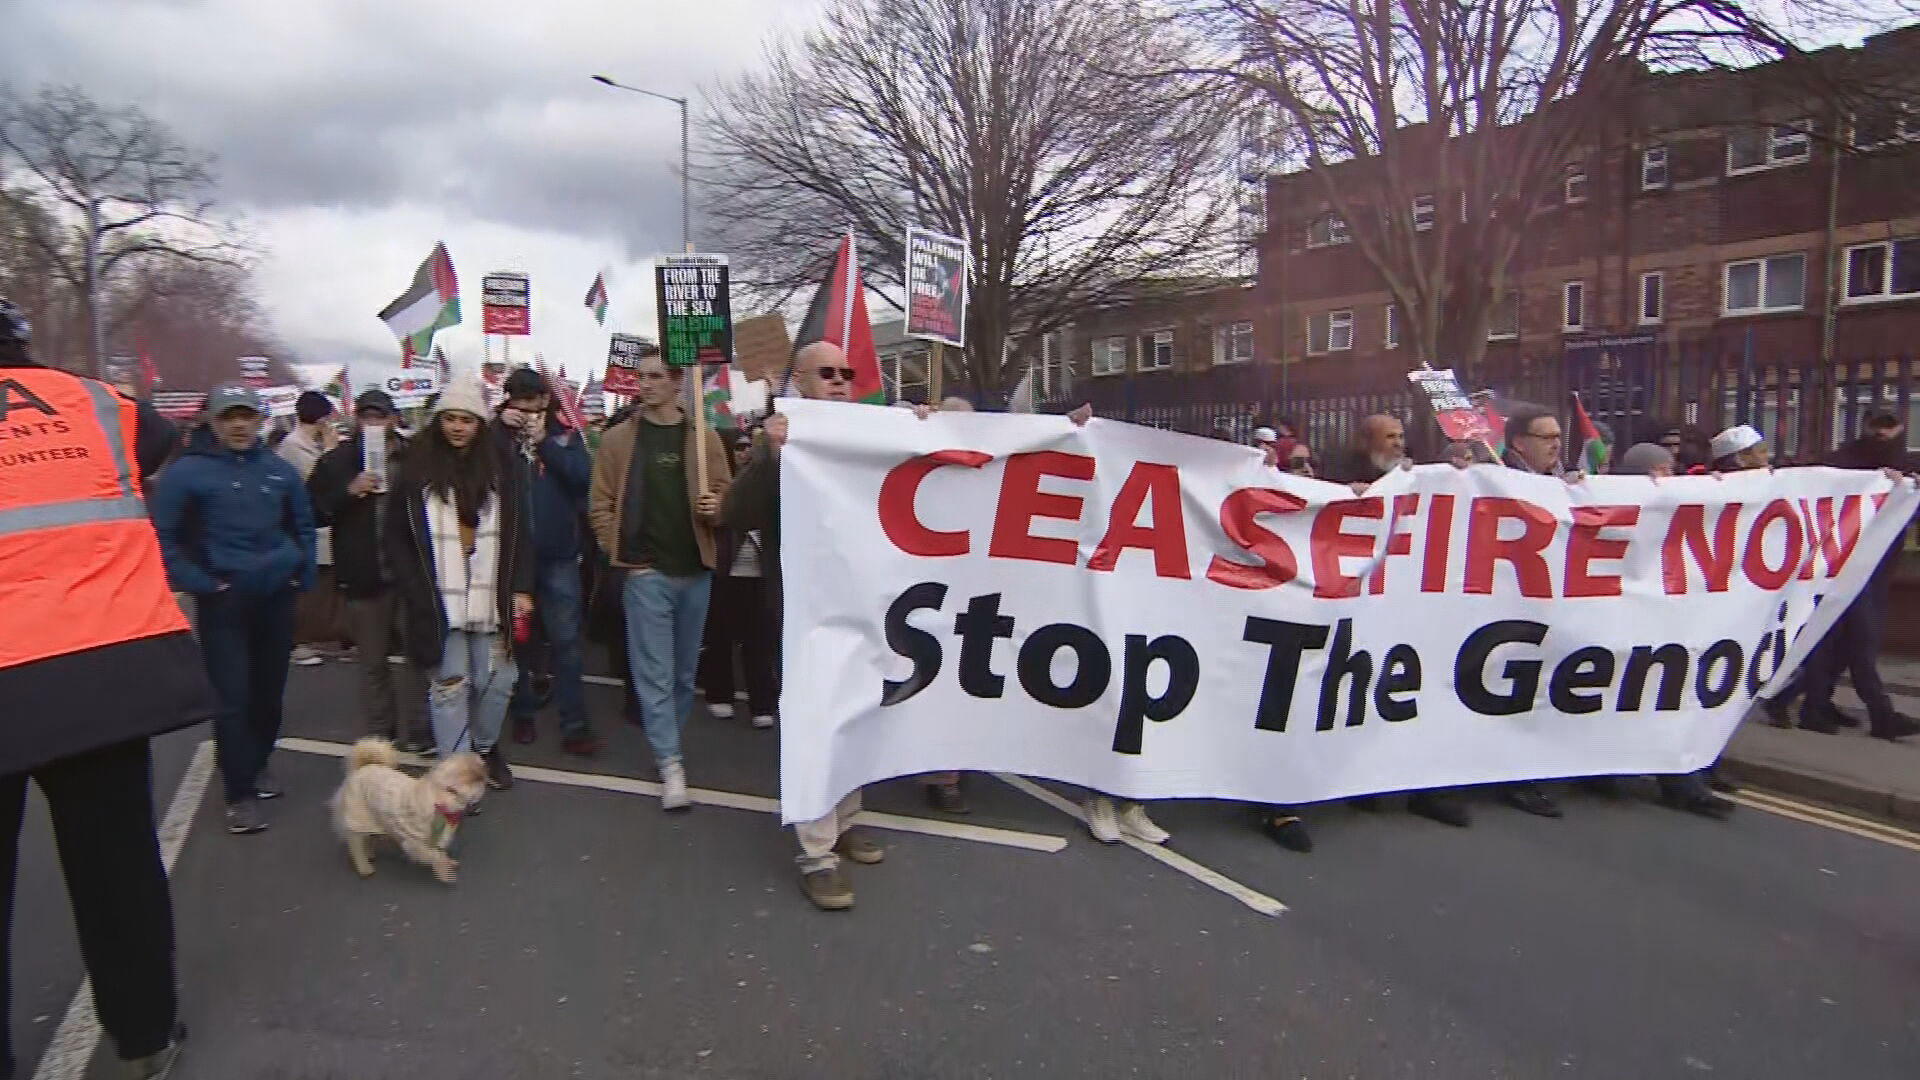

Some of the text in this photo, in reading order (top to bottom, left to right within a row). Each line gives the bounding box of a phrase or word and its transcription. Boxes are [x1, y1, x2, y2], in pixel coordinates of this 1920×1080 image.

[664, 268, 721, 284] FROM THE
[664, 284, 716, 300] RIVER TO
[666, 300, 713, 316] THE SEA
[878, 449, 1640, 598] CEASEFIRE
[880, 582, 1824, 754] Stop The Genoci
